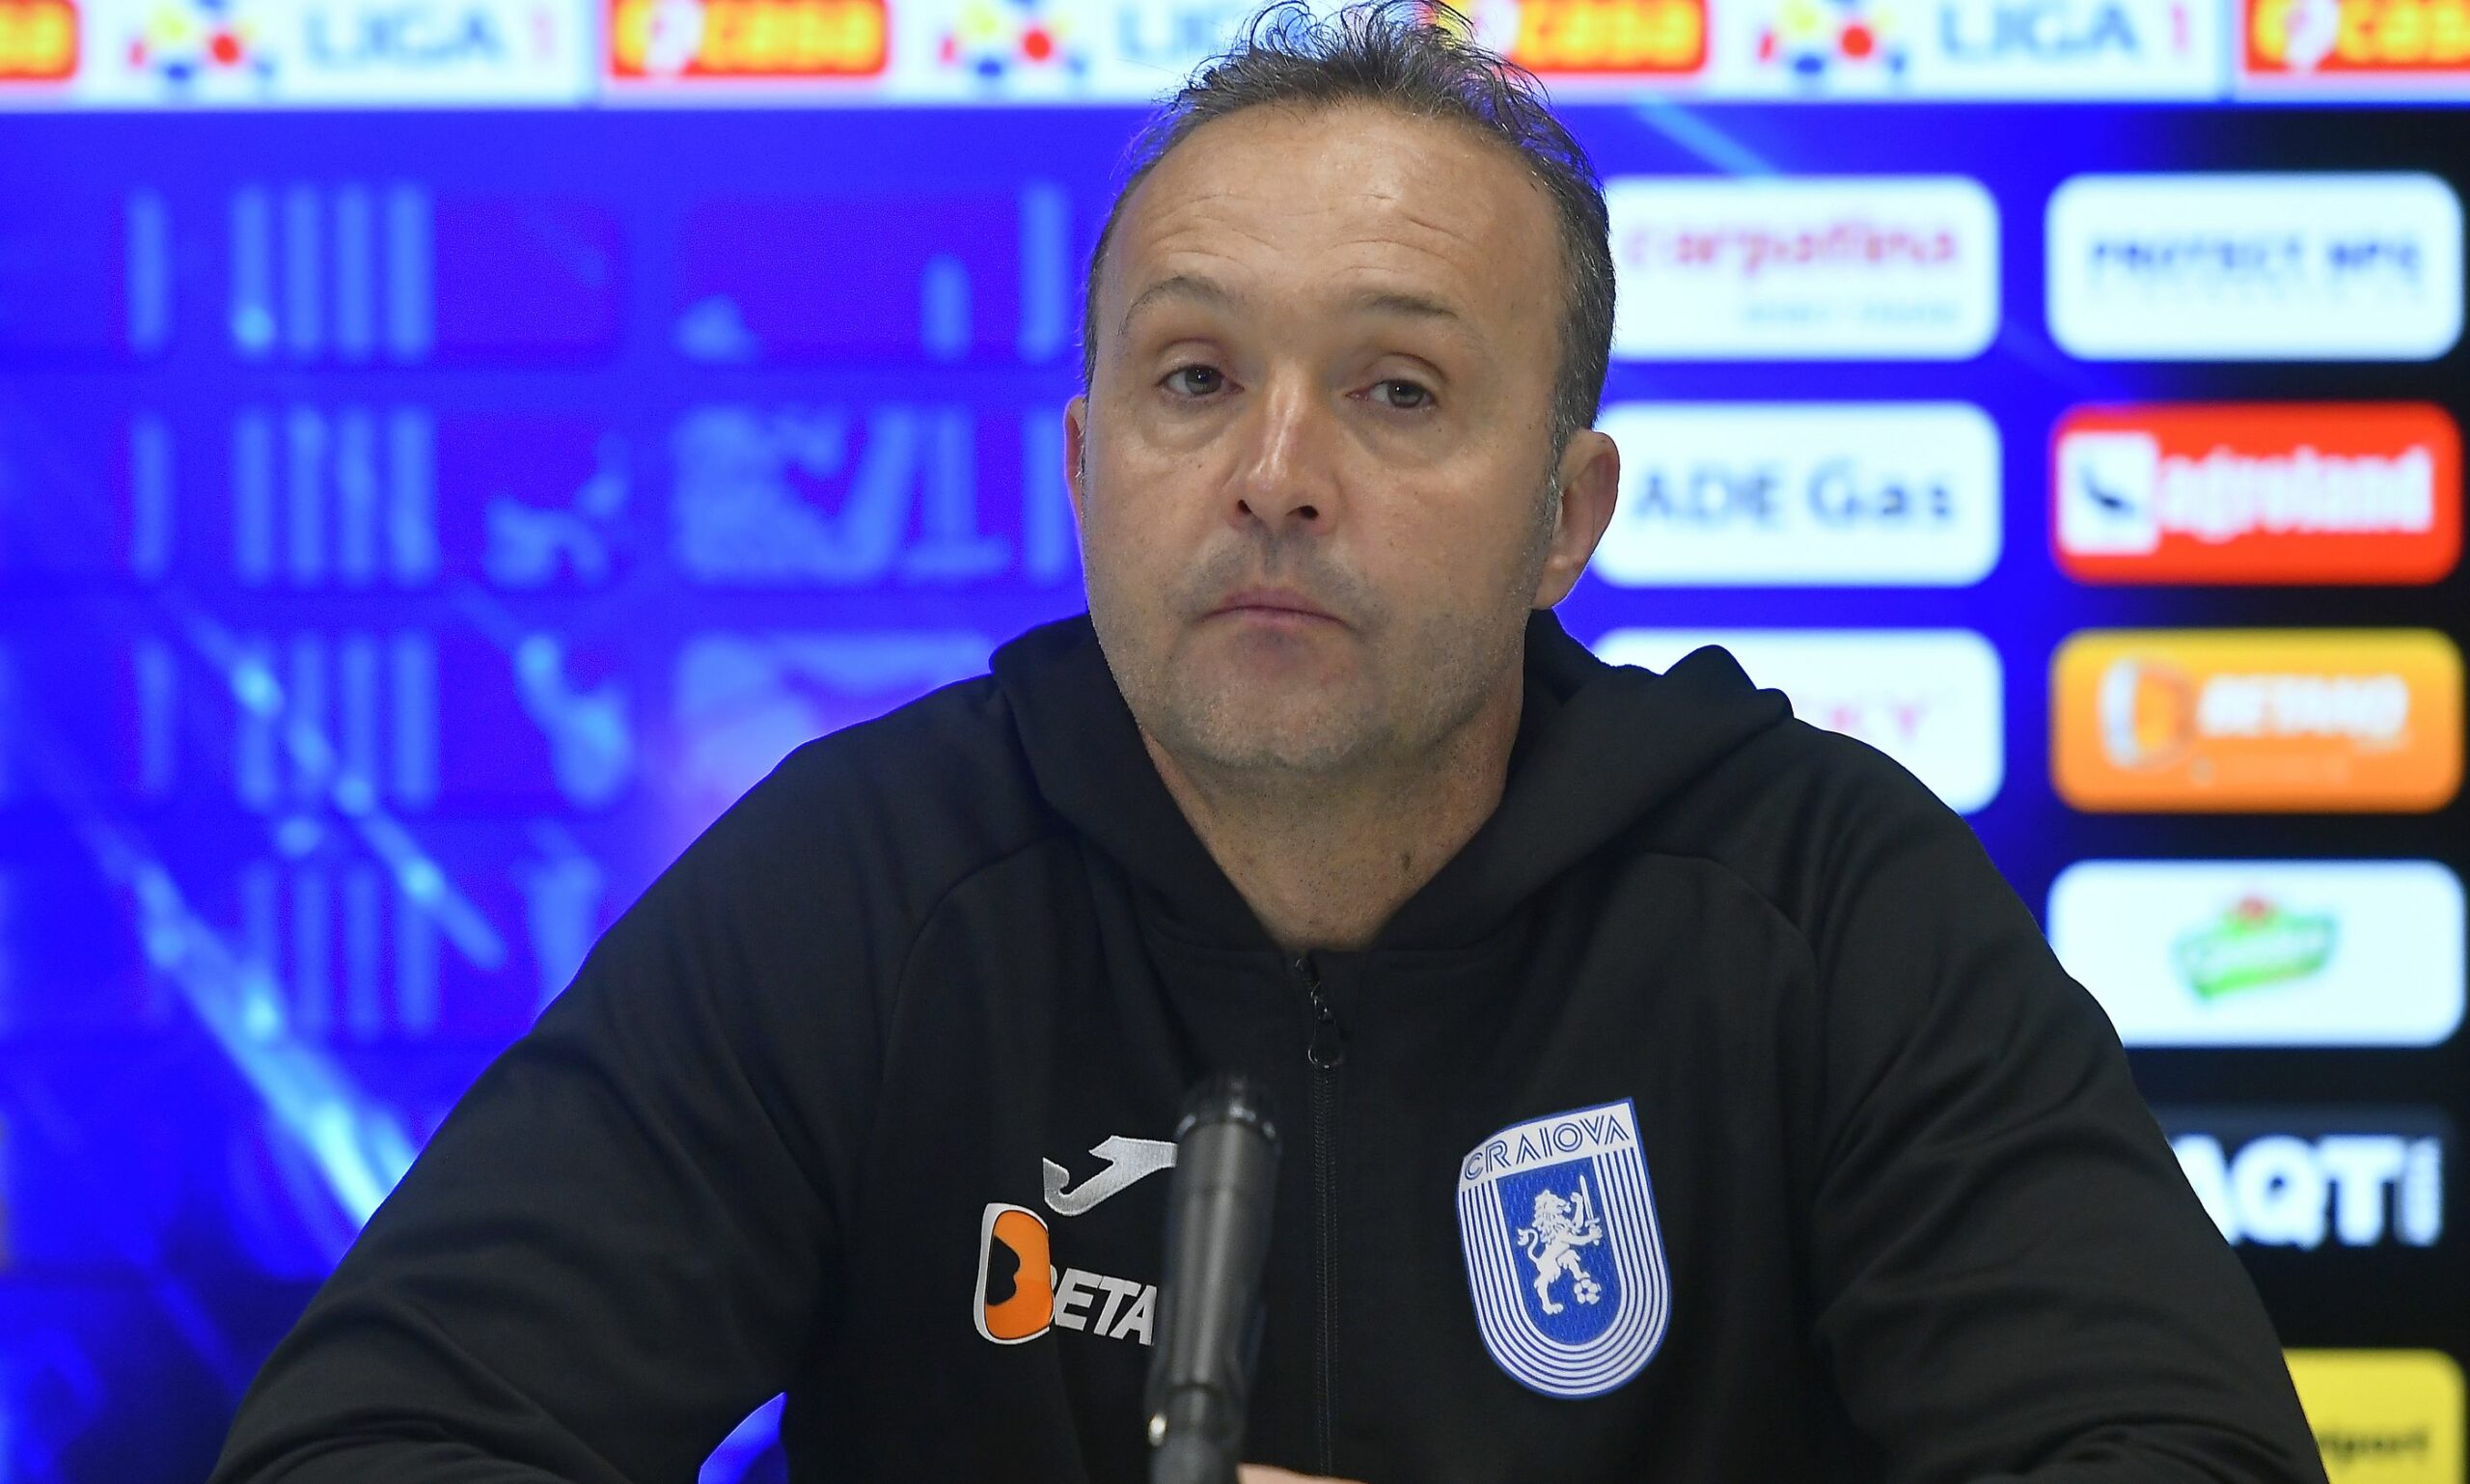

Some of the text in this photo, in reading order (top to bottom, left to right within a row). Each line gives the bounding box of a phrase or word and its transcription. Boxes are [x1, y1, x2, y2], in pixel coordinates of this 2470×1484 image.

[304, 6, 505, 66] LIGA
[1940, 3, 2139, 60] LIGA
[1633, 460, 1955, 525] ADE Gas
[2162, 444, 2433, 545] agroland
[1464, 1113, 1631, 1181] CRAIOVA
[973, 1202, 1158, 1346] BETA
